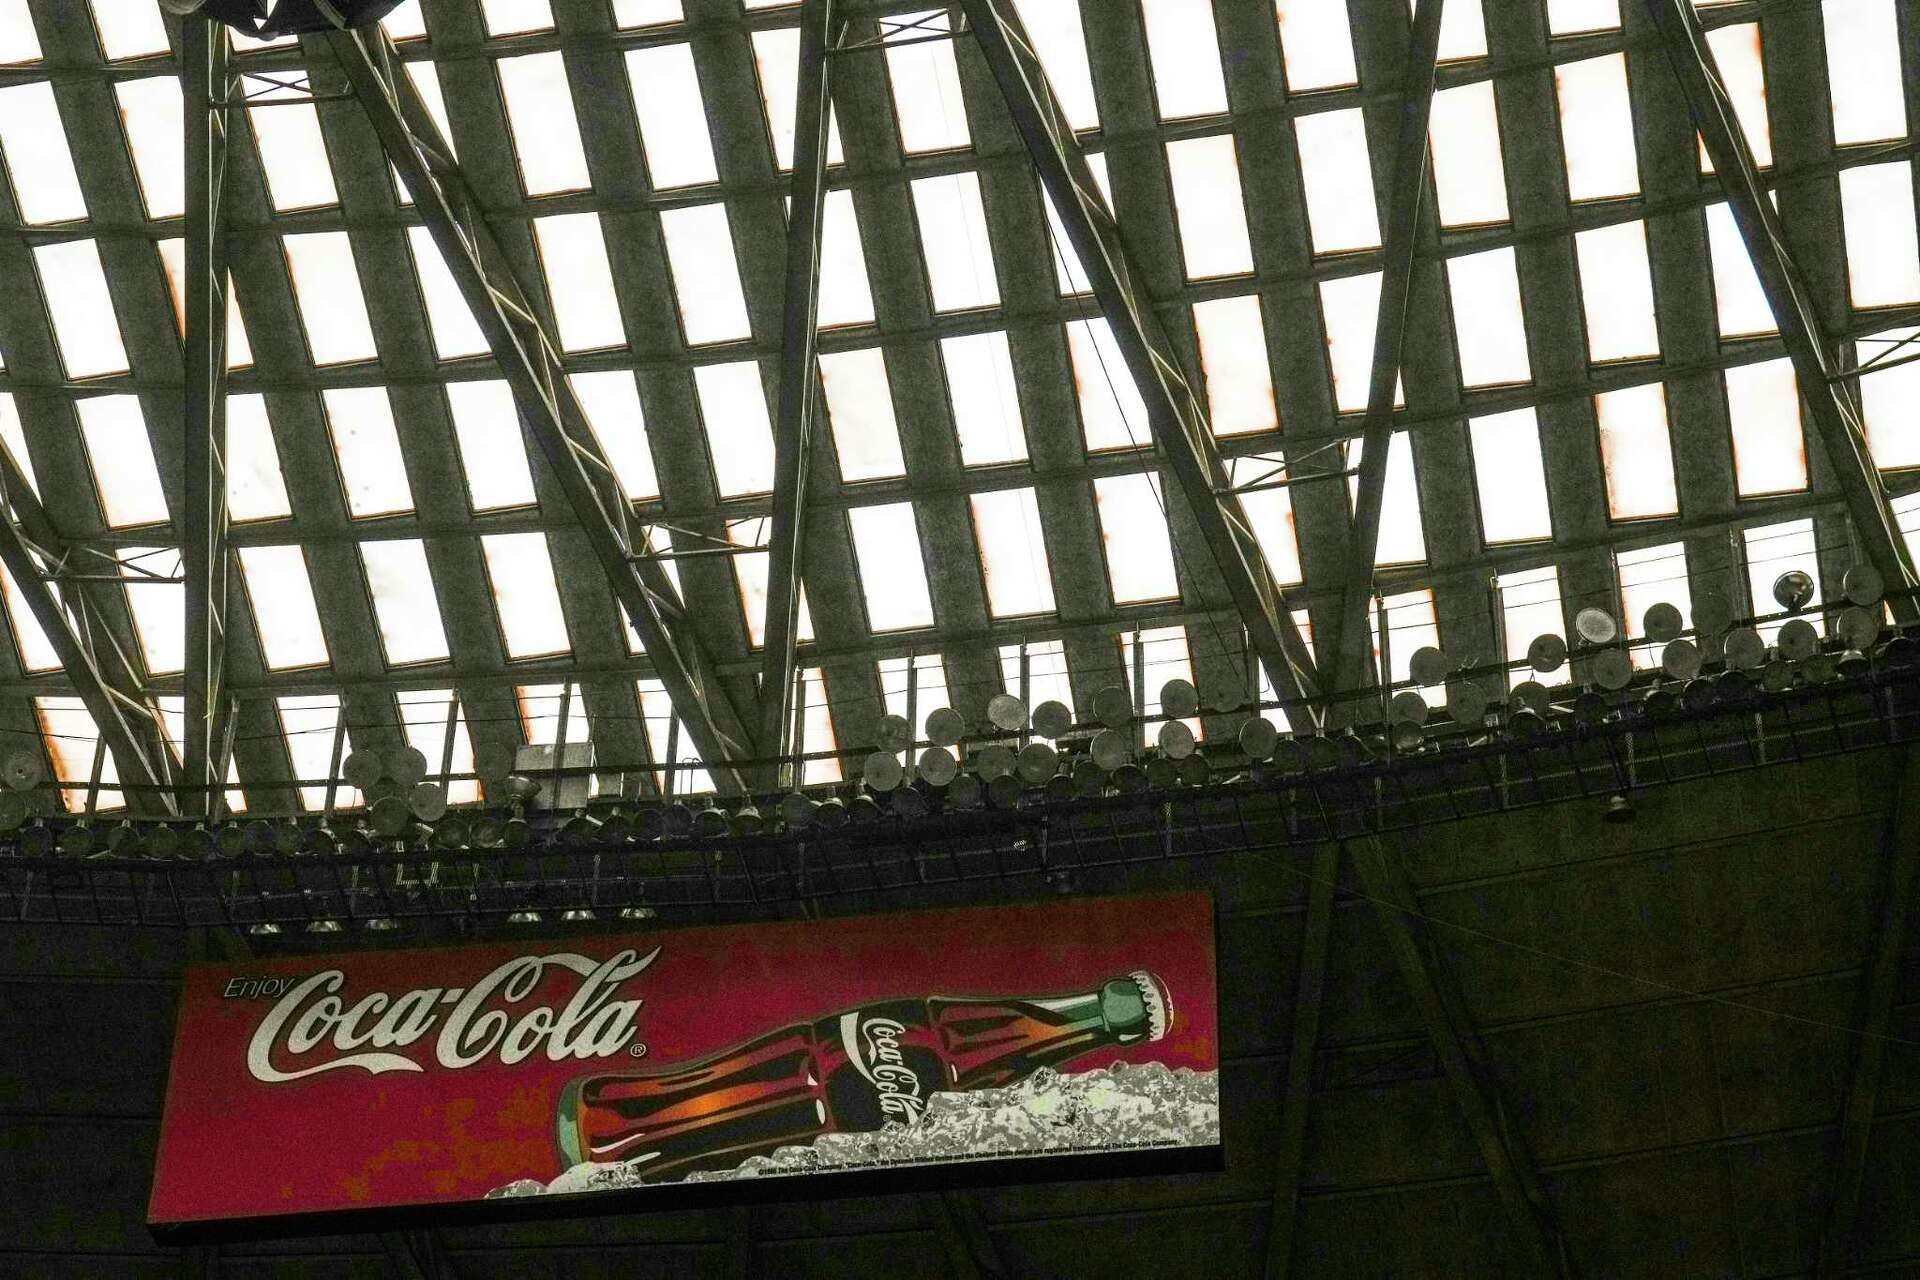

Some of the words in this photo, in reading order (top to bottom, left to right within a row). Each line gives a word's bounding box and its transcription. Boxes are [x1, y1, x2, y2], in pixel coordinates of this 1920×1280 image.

[223, 975, 296, 1000] Enjoy
[247, 945, 662, 1082] Coca-Cola
[862, 1017, 924, 1126] Coca-Cola
